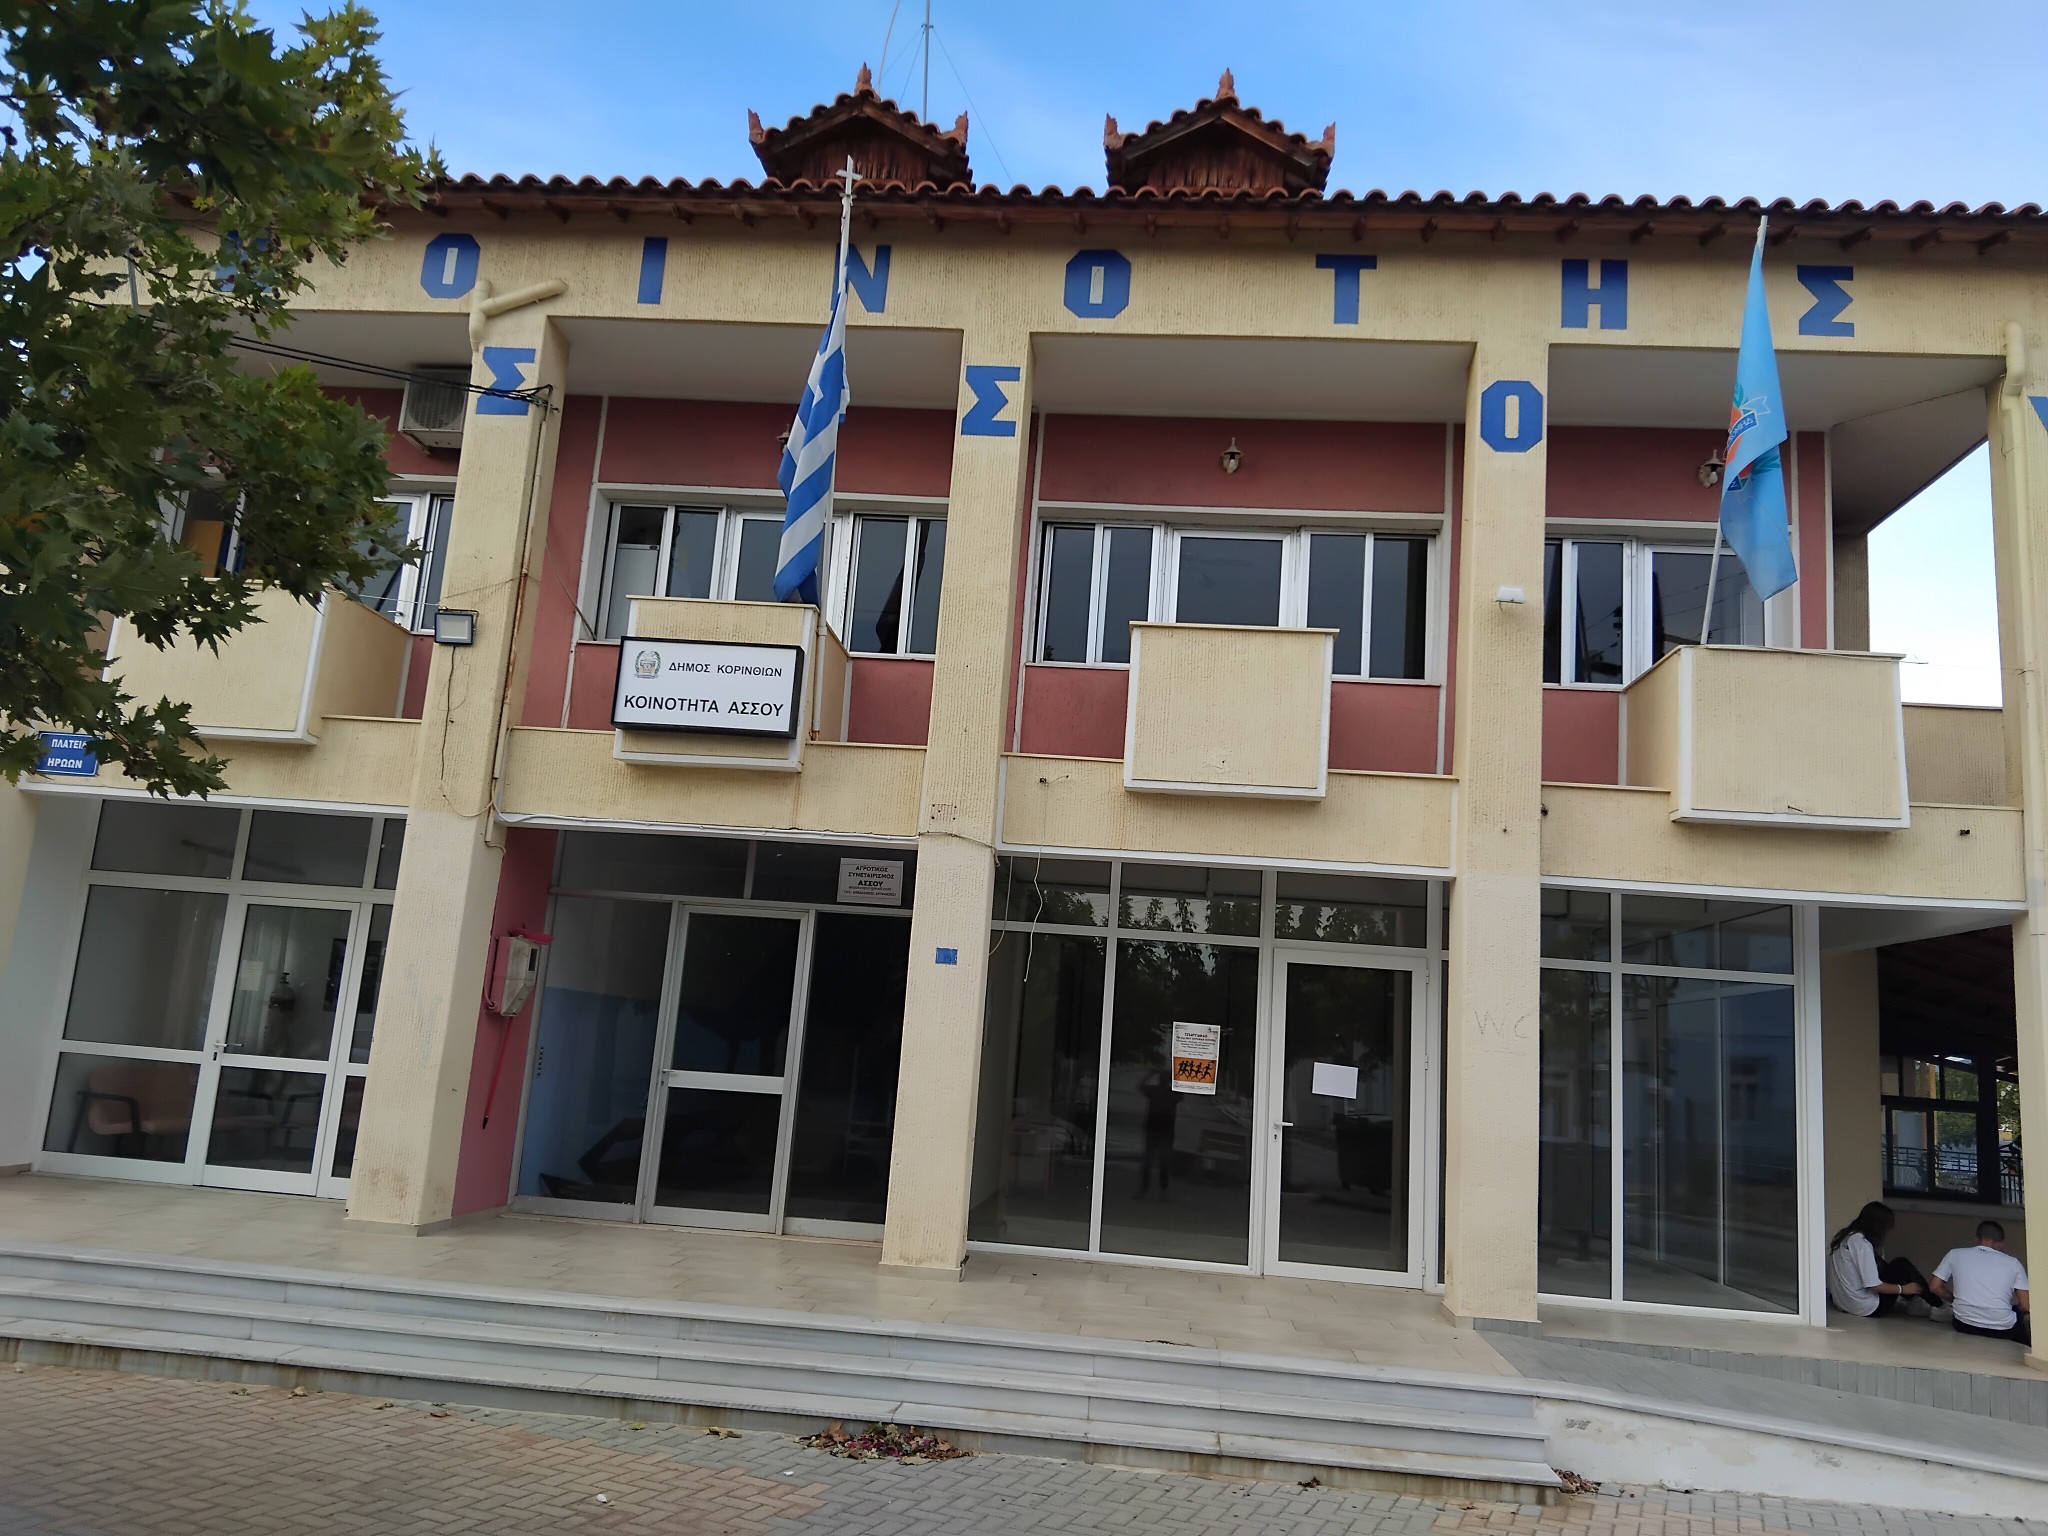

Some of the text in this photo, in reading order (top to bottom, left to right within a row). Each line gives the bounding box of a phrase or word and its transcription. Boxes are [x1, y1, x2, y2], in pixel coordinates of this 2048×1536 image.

[668, 662, 783, 677] ΔΗΜΟΣ ΚΟΡΙΝΘΙΩΝ
[624, 695, 784, 717] ΚΟΙΝΟΤΗΤΑ ΑΣΣΟΥ
[47, 757, 83, 769] ΗΡΩΩΝ
